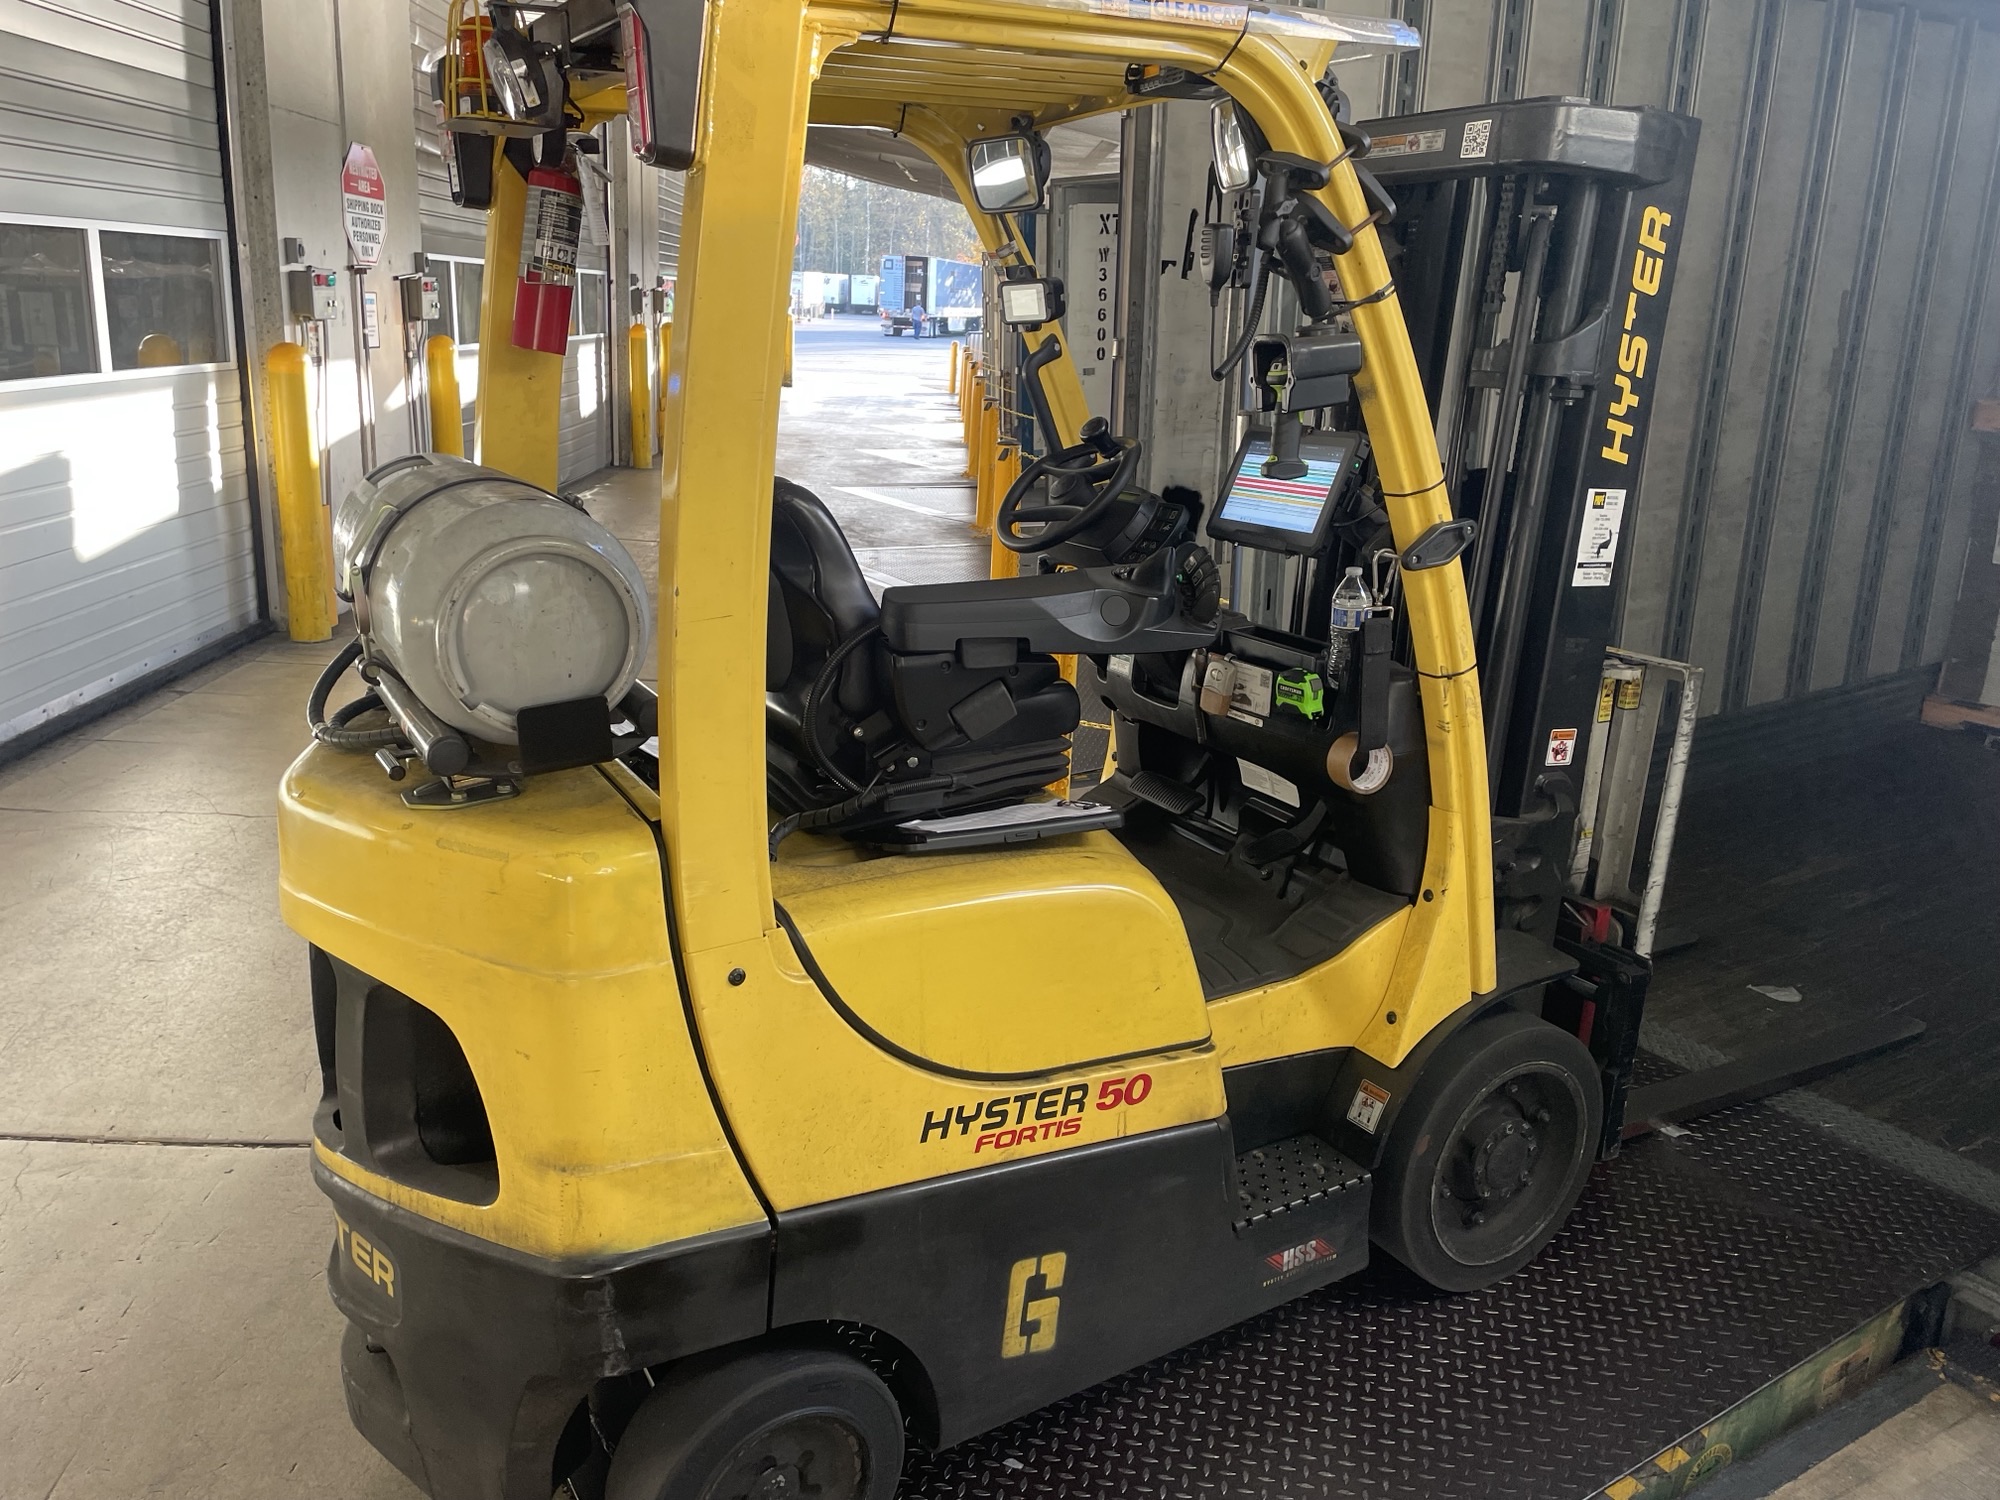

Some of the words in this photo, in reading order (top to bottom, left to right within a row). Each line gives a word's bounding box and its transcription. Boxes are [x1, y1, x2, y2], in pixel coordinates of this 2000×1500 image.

[348, 161, 378, 180] RESTRICTED
[357, 180, 371, 194] AREA
[346, 198, 370, 213] SHIPPING
[370, 201, 384, 215] DOCK
[351, 216, 381, 231] AUTHORIZED
[352, 230, 381, 245] PERSONNEL
[361, 245, 374, 257] ONLY
[1601, 205, 1672, 465] HYSTER
[919, 1083, 1089, 1144] HYSTER
[1095, 1073, 1153, 1111] 50
[974, 1116, 1083, 1154] FORTIS
[1282, 1240, 1317, 1273] HSS
[1001, 1251, 1067, 1359] G
